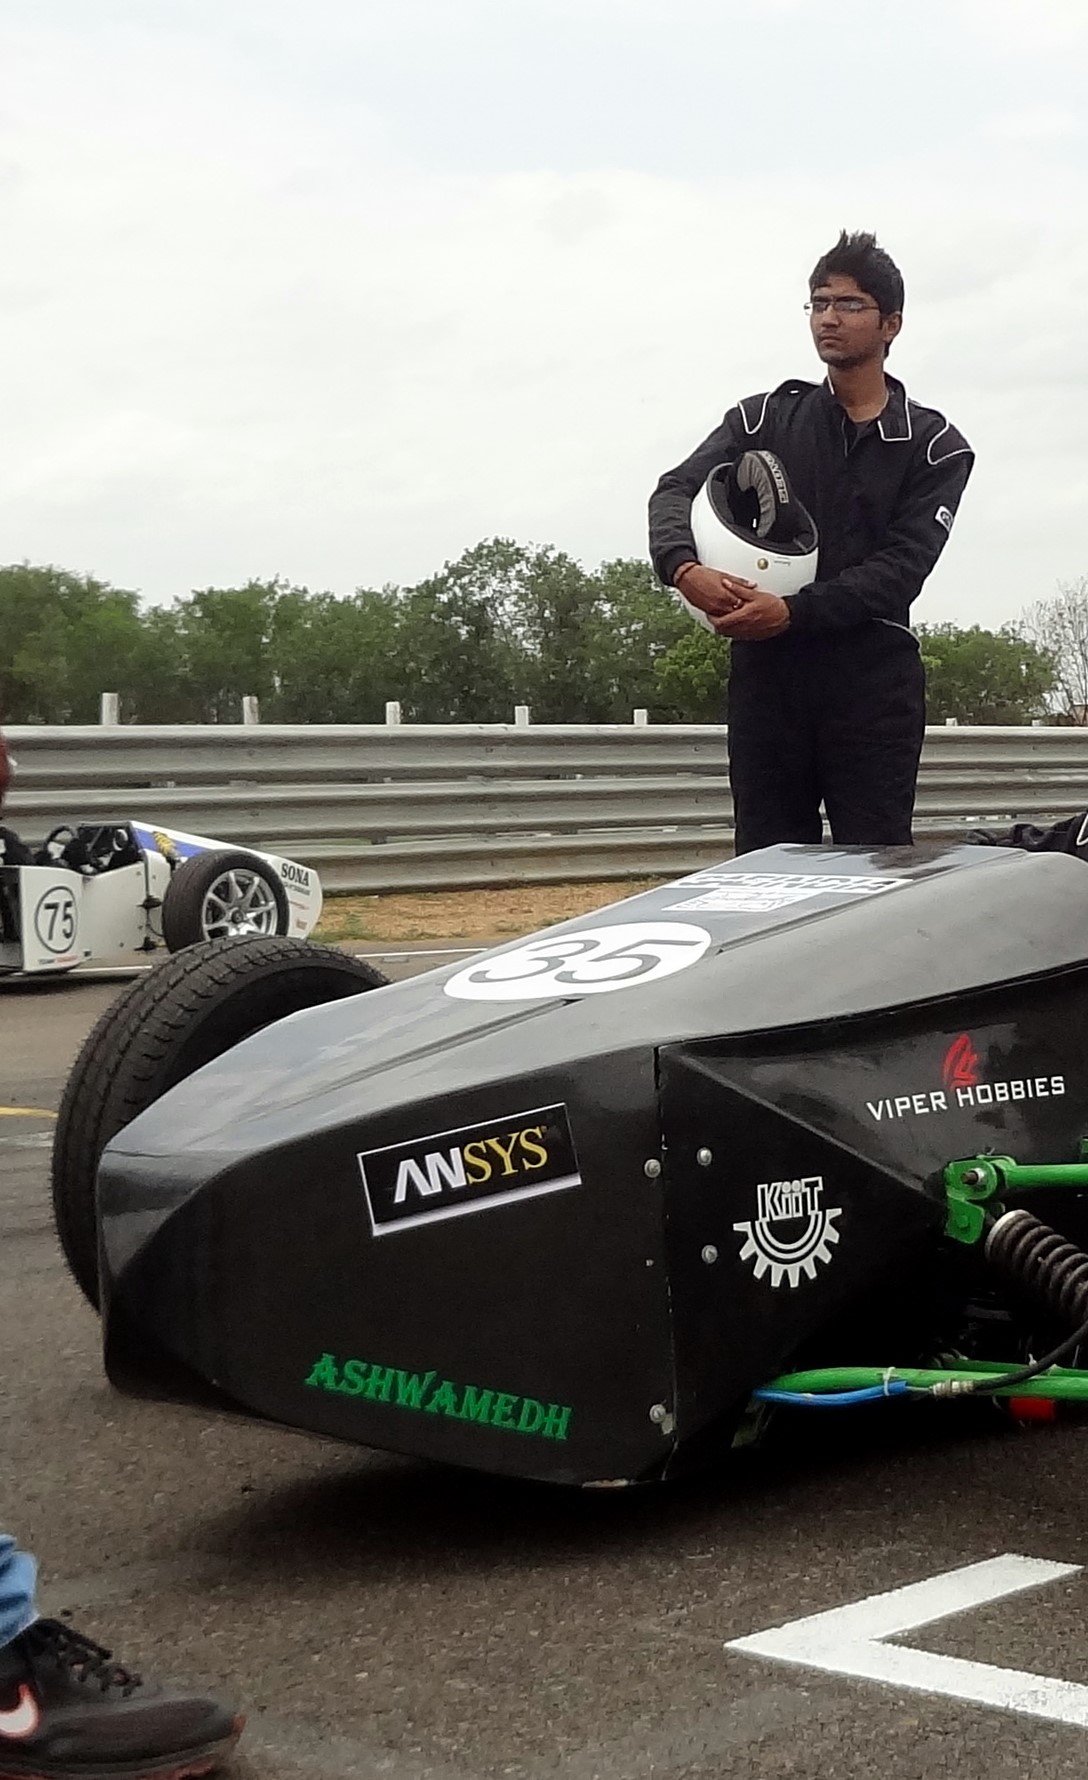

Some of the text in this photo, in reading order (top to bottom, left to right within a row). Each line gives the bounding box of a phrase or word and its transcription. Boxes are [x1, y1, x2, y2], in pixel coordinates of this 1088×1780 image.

[281, 863, 309, 886] SONA
[44, 900, 73, 941] 75
[468, 939, 704, 984] 35
[866, 1076, 1066, 1120] VIPER HOBBIES
[394, 1126, 548, 1204] ANSYS
[305, 1353, 572, 1440] ASHWAMEDH
